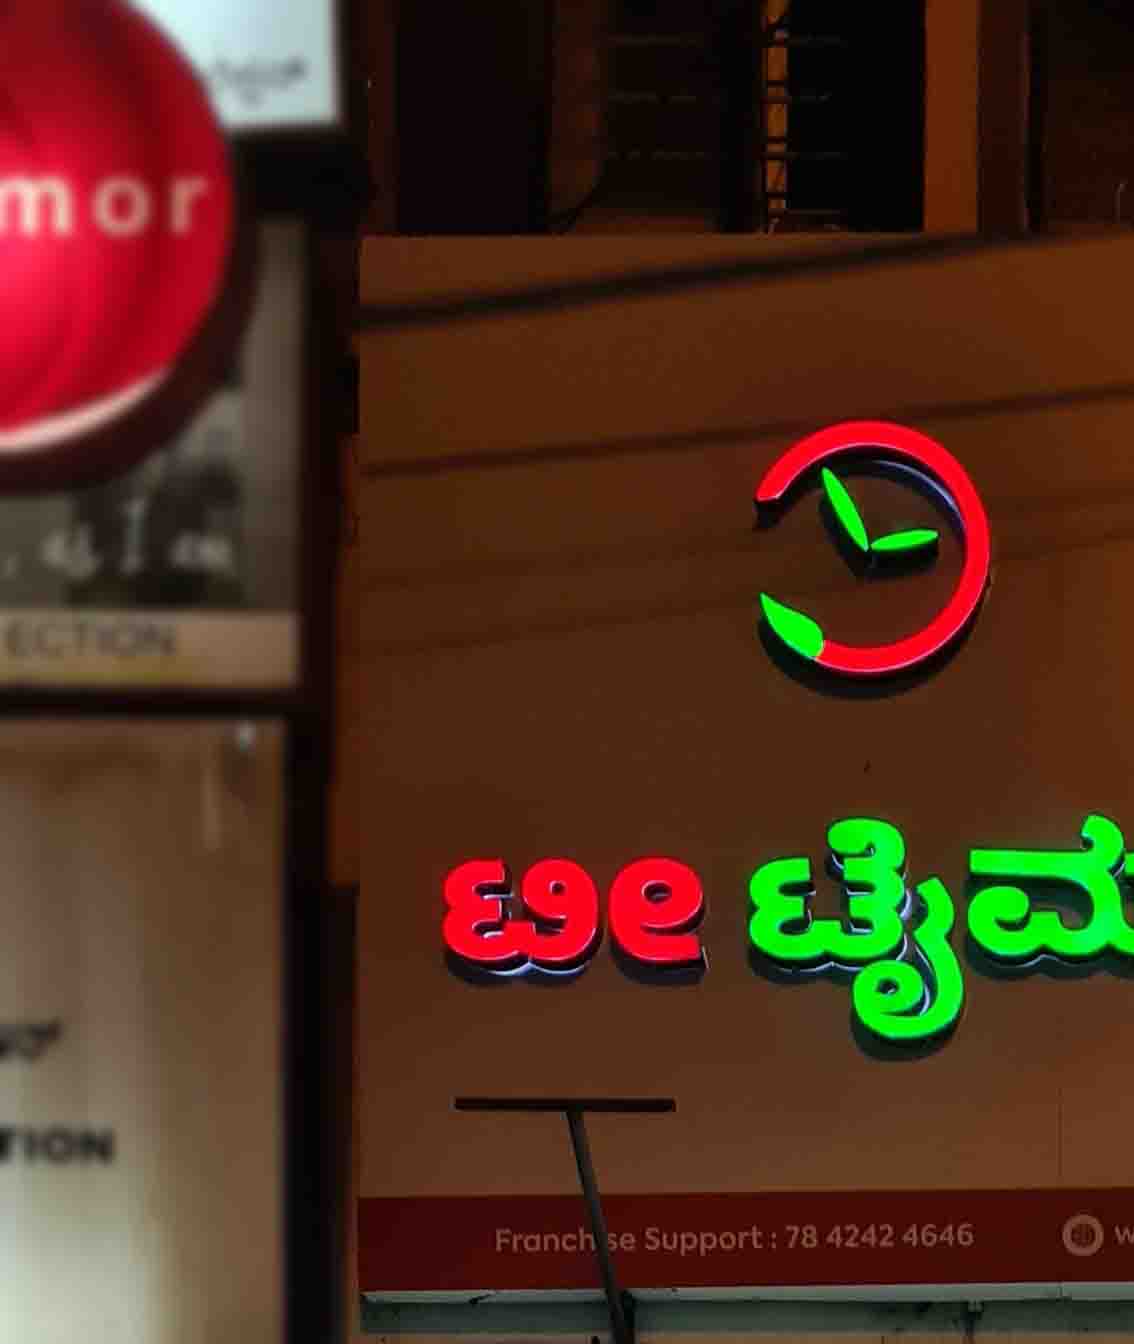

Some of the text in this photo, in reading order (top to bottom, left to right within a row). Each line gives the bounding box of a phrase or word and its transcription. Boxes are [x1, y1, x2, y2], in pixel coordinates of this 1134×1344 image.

[443, 856, 703, 963] ಟೀ
[494, 1227, 636, 1252] Franchse
[643, 1226, 763, 1257] Support
[785, 1225, 819, 1249] 78
[826, 1224, 895, 1249] 4242
[901, 1223, 974, 1248] 4646
